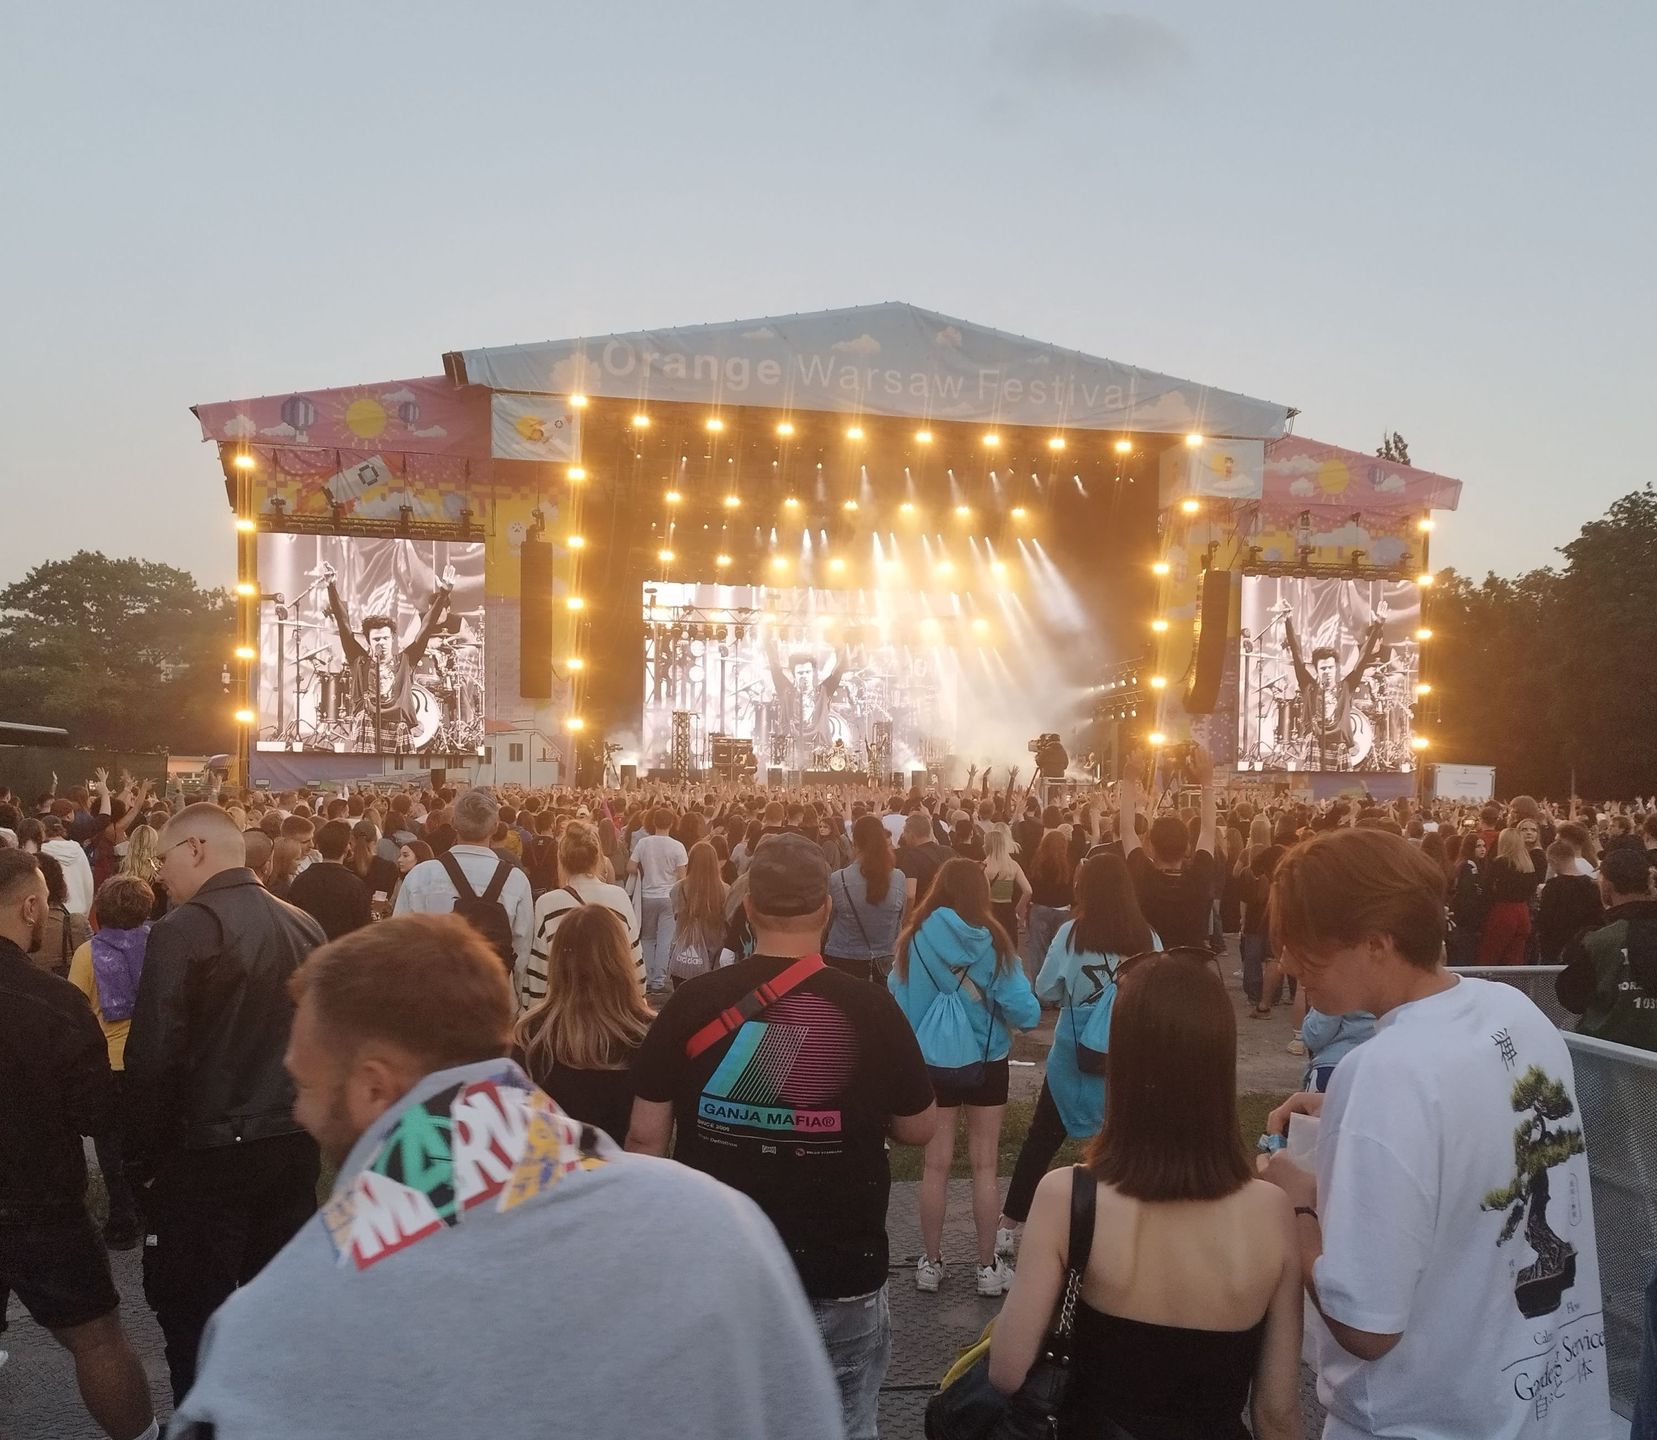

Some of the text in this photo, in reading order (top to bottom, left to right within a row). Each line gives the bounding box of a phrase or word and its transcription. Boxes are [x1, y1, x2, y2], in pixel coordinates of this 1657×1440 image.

[603, 340, 1137, 409] Orange Warsaw Festival
[703, 1103, 762, 1123] GANJA
